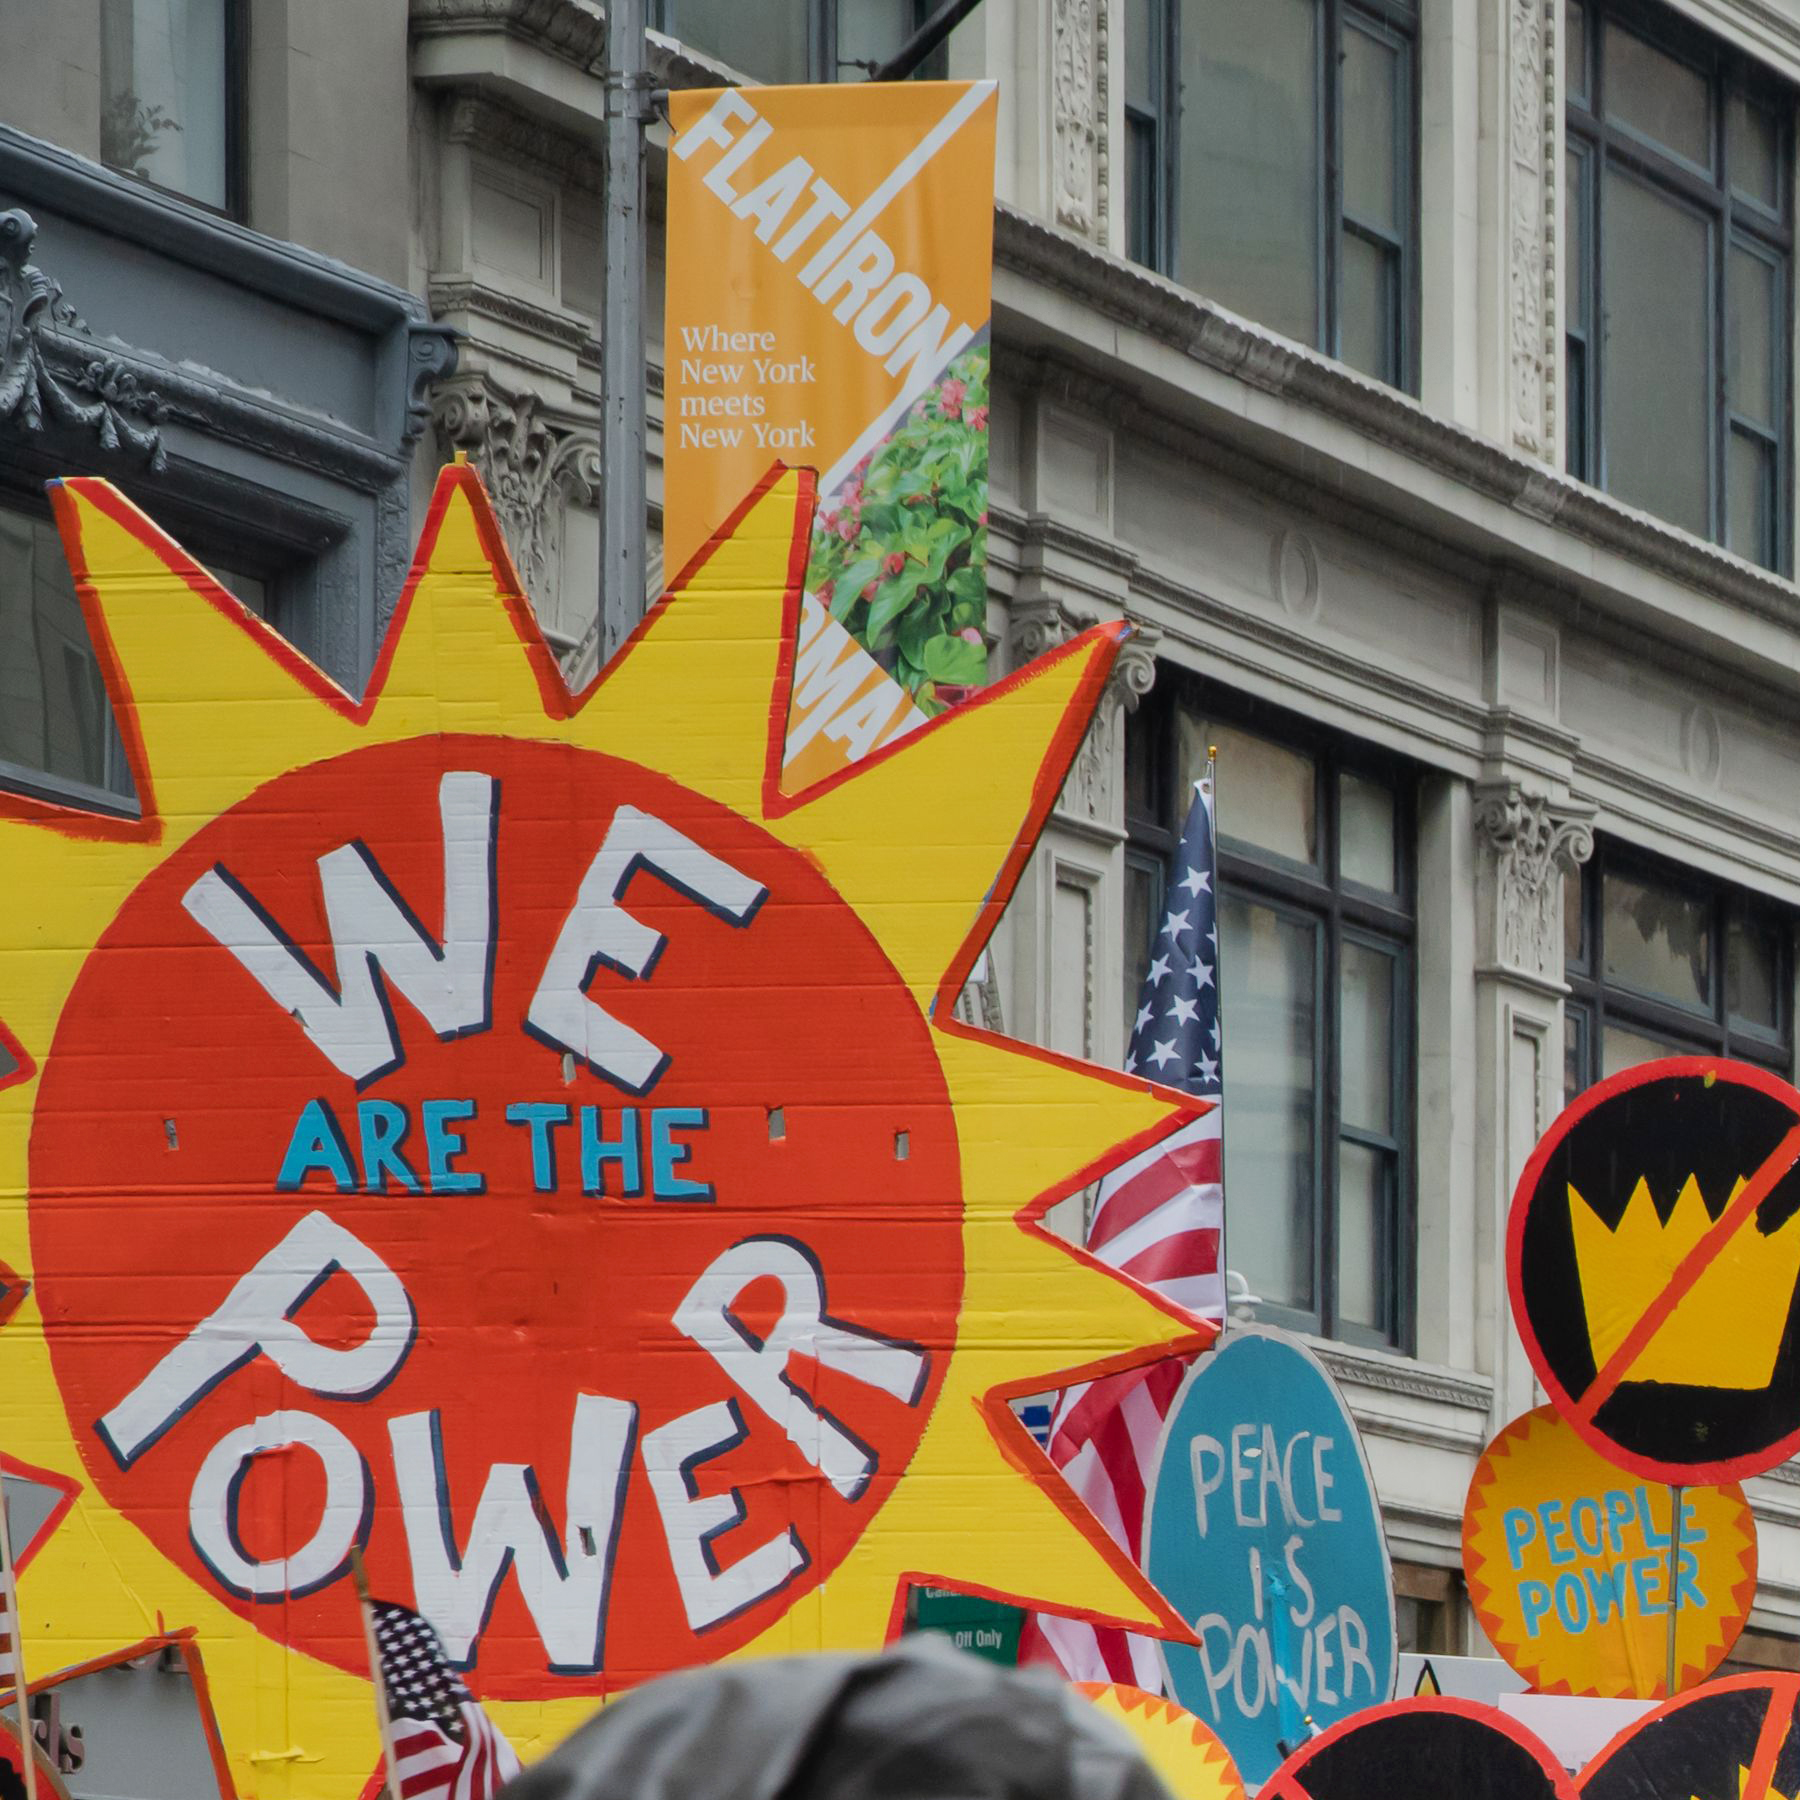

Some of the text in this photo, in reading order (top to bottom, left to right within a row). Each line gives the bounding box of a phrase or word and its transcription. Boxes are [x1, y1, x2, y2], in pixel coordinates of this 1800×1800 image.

[672, 86, 976, 380] FLATIRON
[680, 324, 776, 352] Where
[680, 356, 816, 384] New York
[679, 393, 765, 417] meets
[680, 420, 816, 449] New York
[183, 770, 768, 1095] WE
[276, 1098, 716, 1203] ARE THE
[95, 1209, 931, 1676] POWER
[1190, 1423, 1342, 1538] PEACE
[1503, 1481, 1709, 1569] PEOPLE
[1249, 1534, 1315, 1628] IS
[1516, 1547, 1709, 1640] POWER
[956, 1628, 1002, 1649] Off Only
